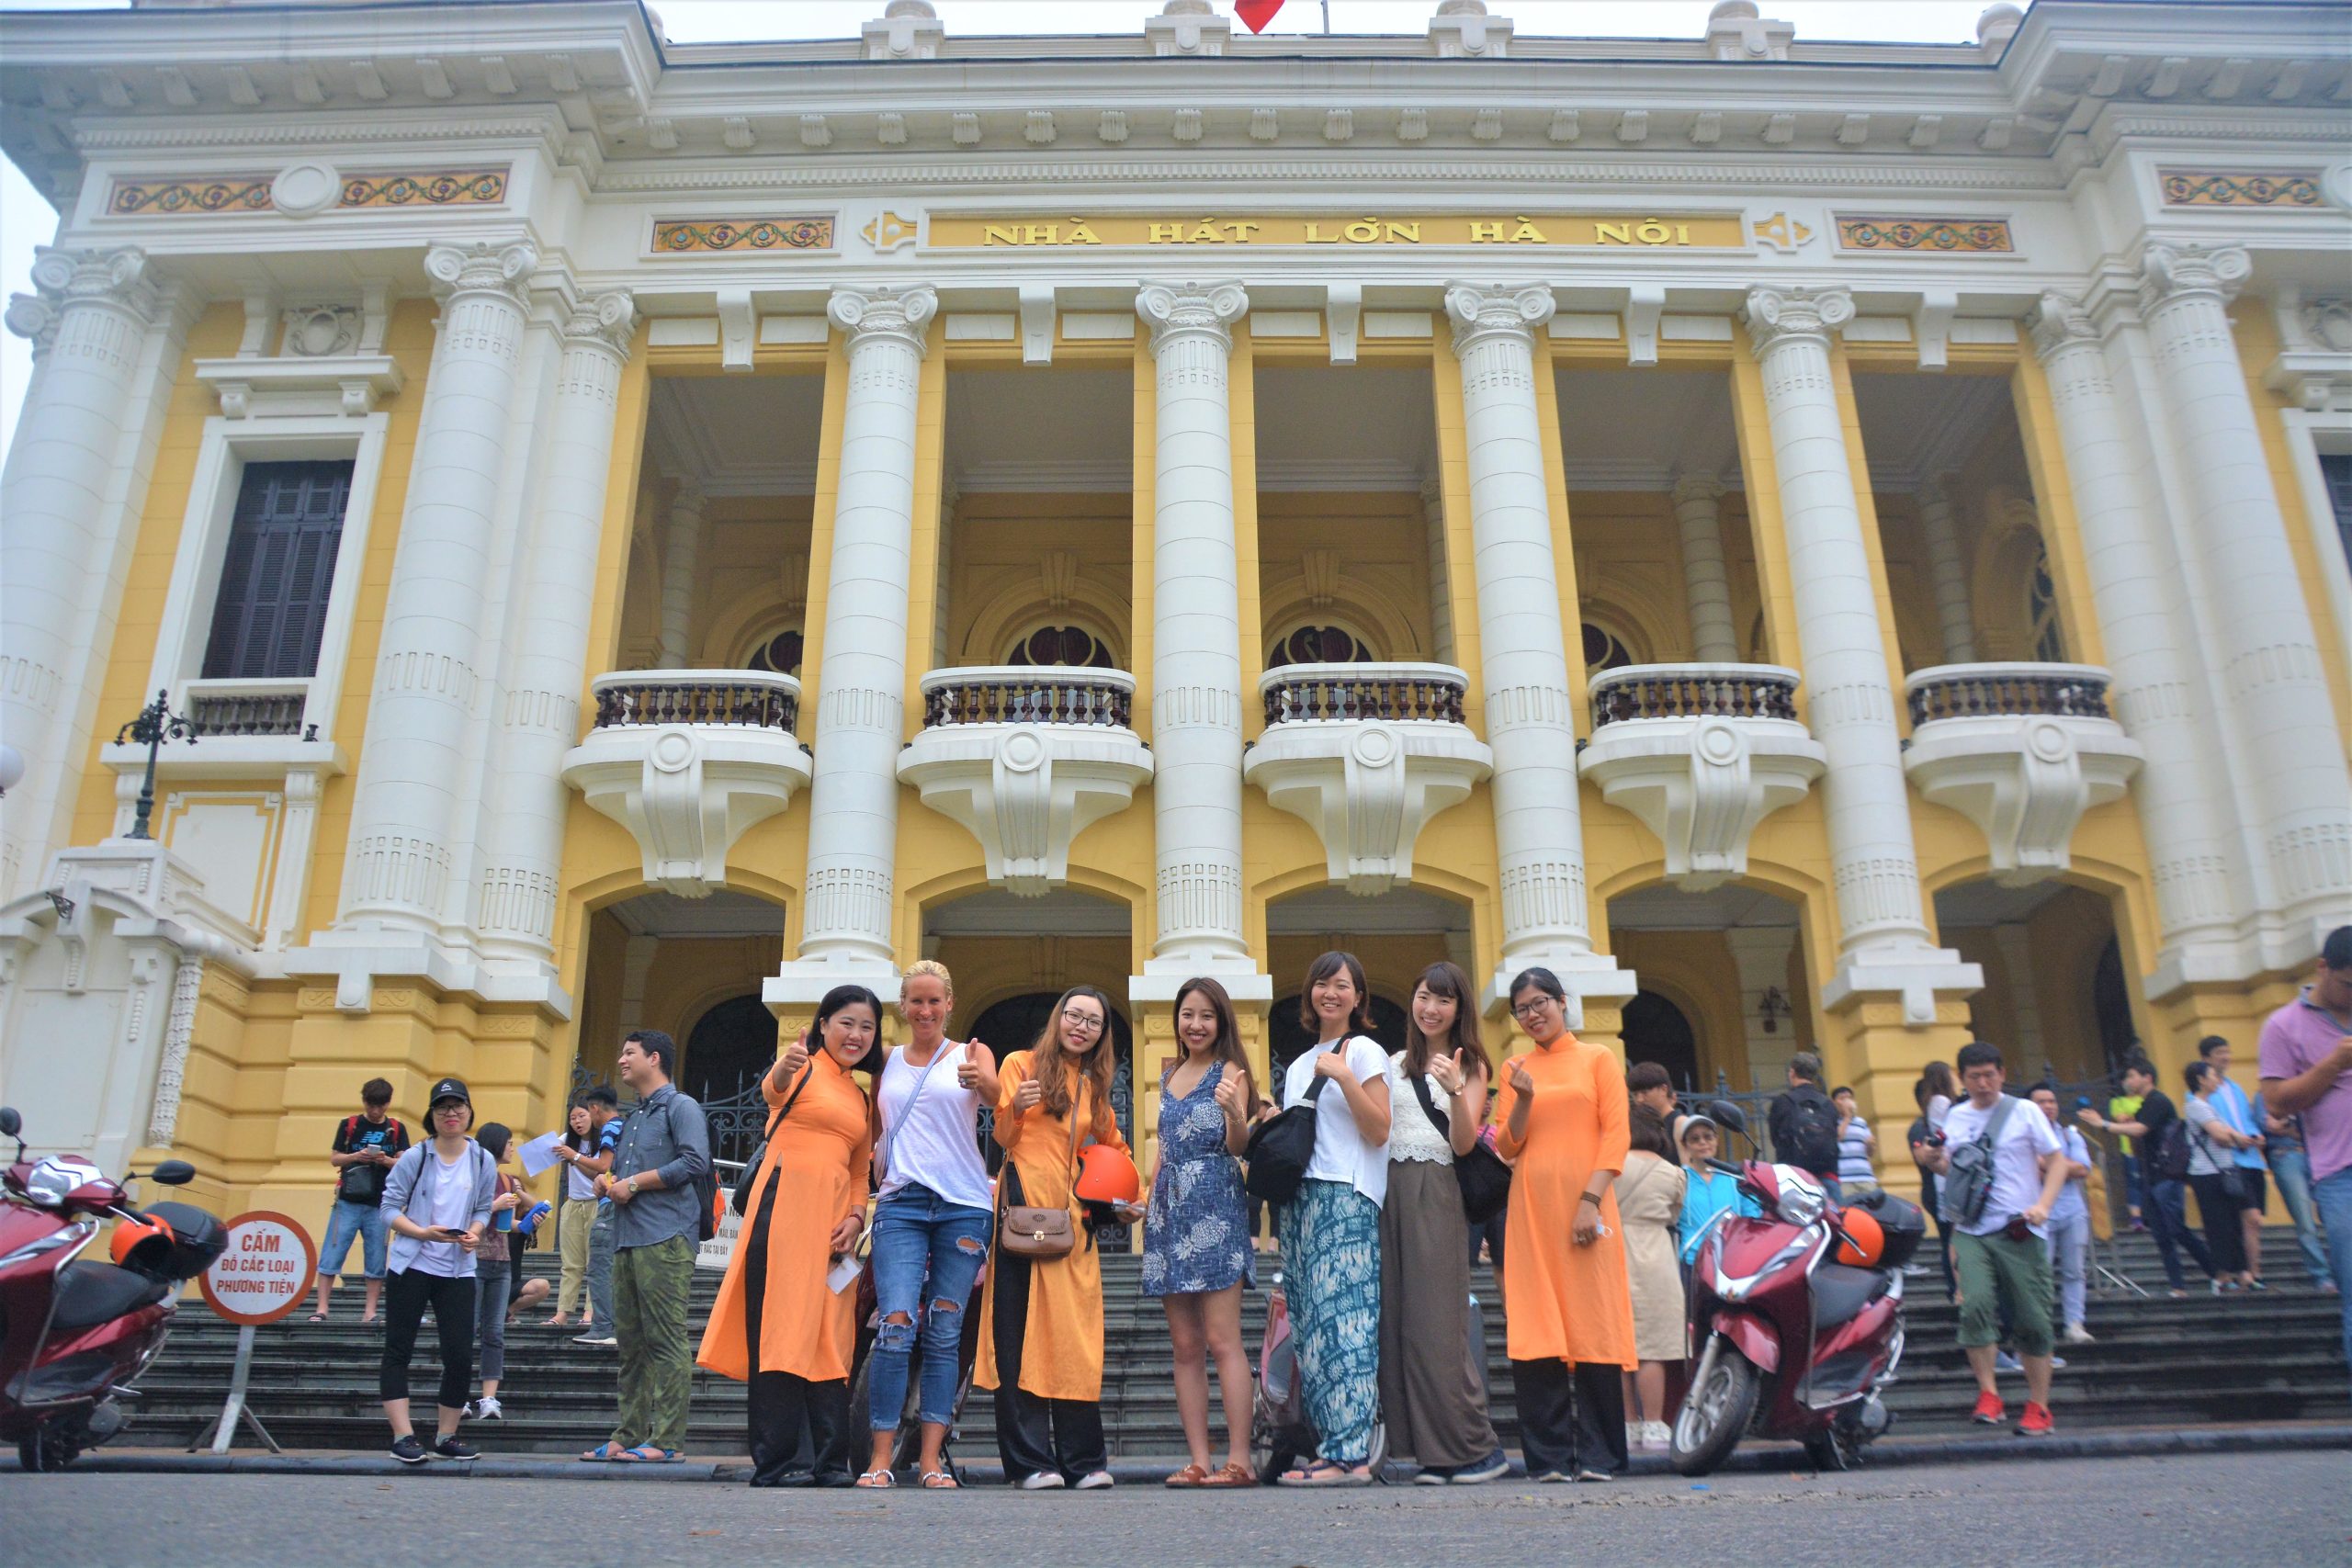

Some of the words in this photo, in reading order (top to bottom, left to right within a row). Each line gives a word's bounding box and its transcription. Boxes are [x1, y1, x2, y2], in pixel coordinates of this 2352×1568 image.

[983, 216, 1102, 245] NHÀ
[1148, 216, 1260, 243] HÁT
[1305, 216, 1420, 243] LỚN
[1469, 216, 1548, 243] HÀ
[1594, 217, 1690, 246] NỘI
[242, 1228, 280, 1252] CẤM
[241, 1255, 264, 1271] CÁC
[268, 1260, 294, 1275] LOẠI
[216, 1280, 265, 1293] PHƯƠNG
[268, 1279, 295, 1296] TIỆN
